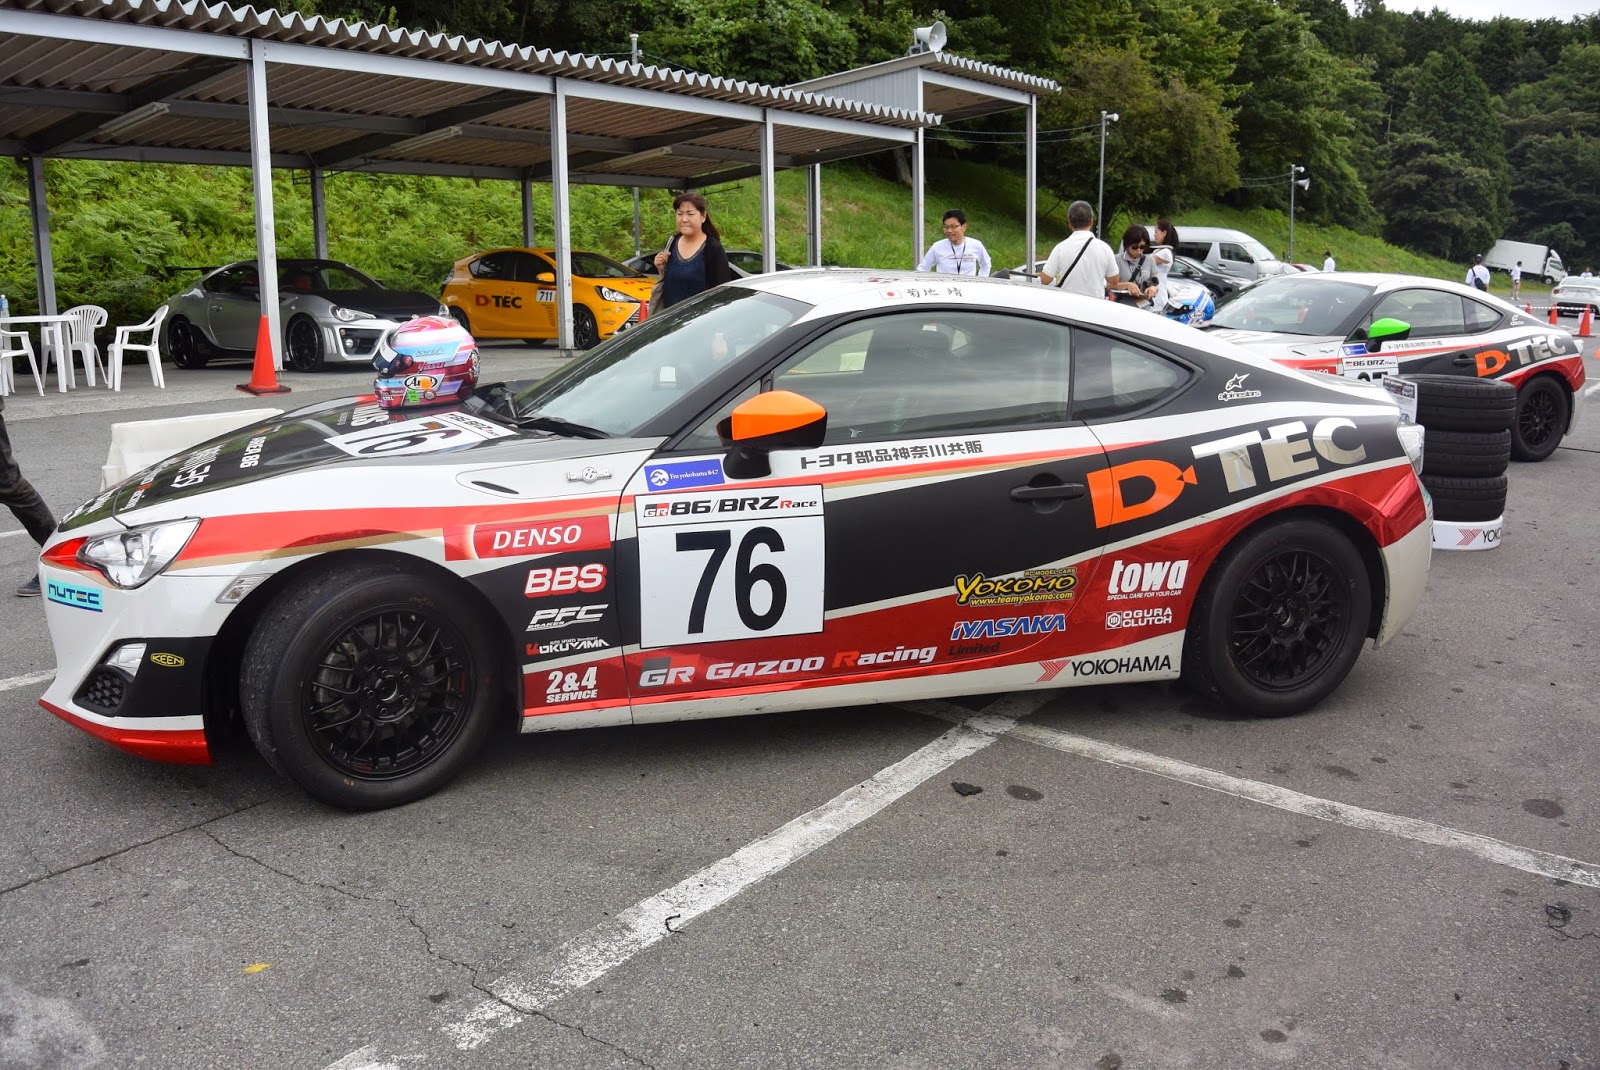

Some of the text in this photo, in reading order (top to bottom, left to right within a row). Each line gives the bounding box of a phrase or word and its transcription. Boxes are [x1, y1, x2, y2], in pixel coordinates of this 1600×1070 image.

[540, 291, 553, 301] 711
[800, 440, 984, 470] トヨタ部品神奈川共販
[492, 524, 582, 550] DENSO
[524, 563, 606, 596] BBS
[676, 526, 788, 634] 76
[1108, 560, 1189, 594] towa
[956, 574, 1076, 603] YOKOMO
[971, 592, 1073, 606] www.teamyokomo.com
[529, 603, 609, 624] PFC
[1122, 607, 1172, 619] OGURA
[1122, 616, 1172, 627] CLUTCH
[152, 654, 184, 666] KEEN
[948, 643, 1000, 656] Limited
[638, 646, 938, 688] GR GAZOO Racing
[1071, 654, 1172, 676] YOKOHAMA
[546, 666, 598, 694] 2&4
[545, 689, 598, 704] SERVICE
